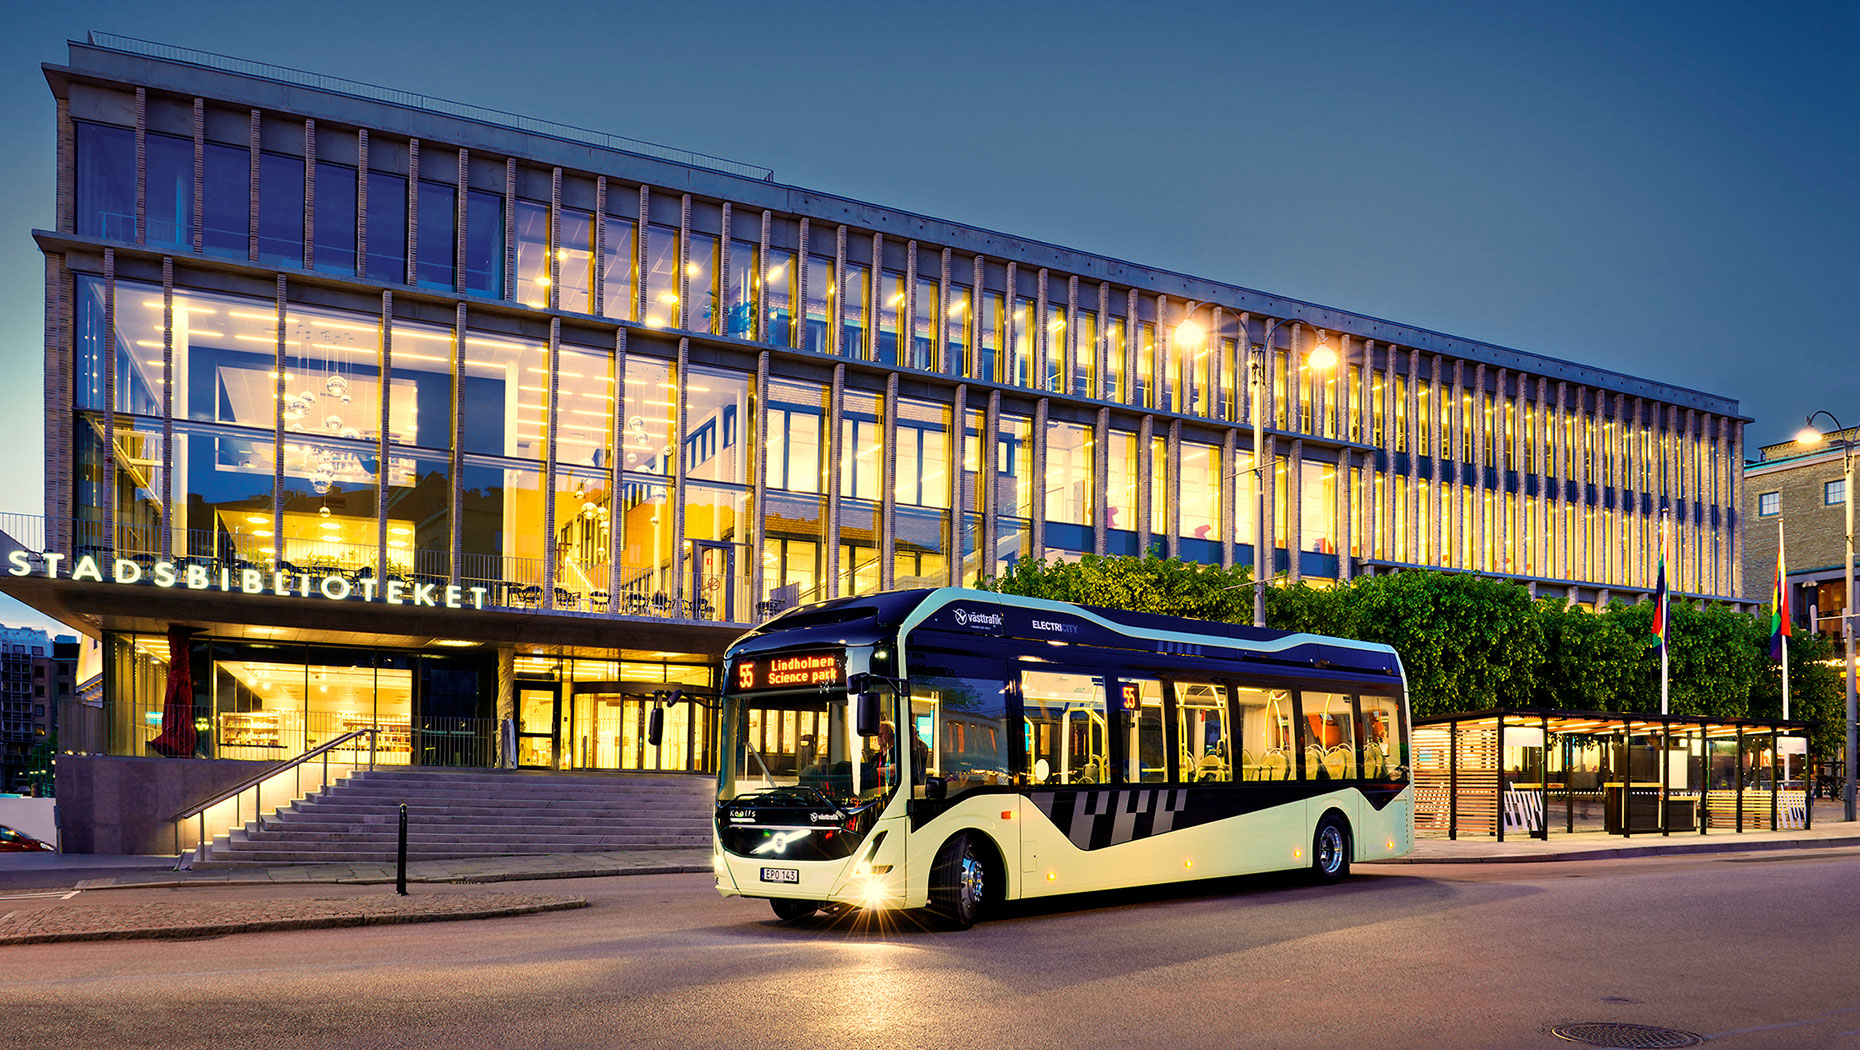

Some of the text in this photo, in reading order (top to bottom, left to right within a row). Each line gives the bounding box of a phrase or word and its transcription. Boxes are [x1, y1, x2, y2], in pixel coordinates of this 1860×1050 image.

[8, 550, 488, 610] STADSBIBLIOTEKET
[967, 611, 1002, 625] västtrafik
[1032, 619, 1078, 634] ELECTRICITY
[771, 656, 835, 672] Lindholmen
[739, 663, 754, 688] 55
[768, 667, 837, 685] Science park
[1122, 686, 1135, 709] 55
[766, 869, 796, 881] EPO 143
